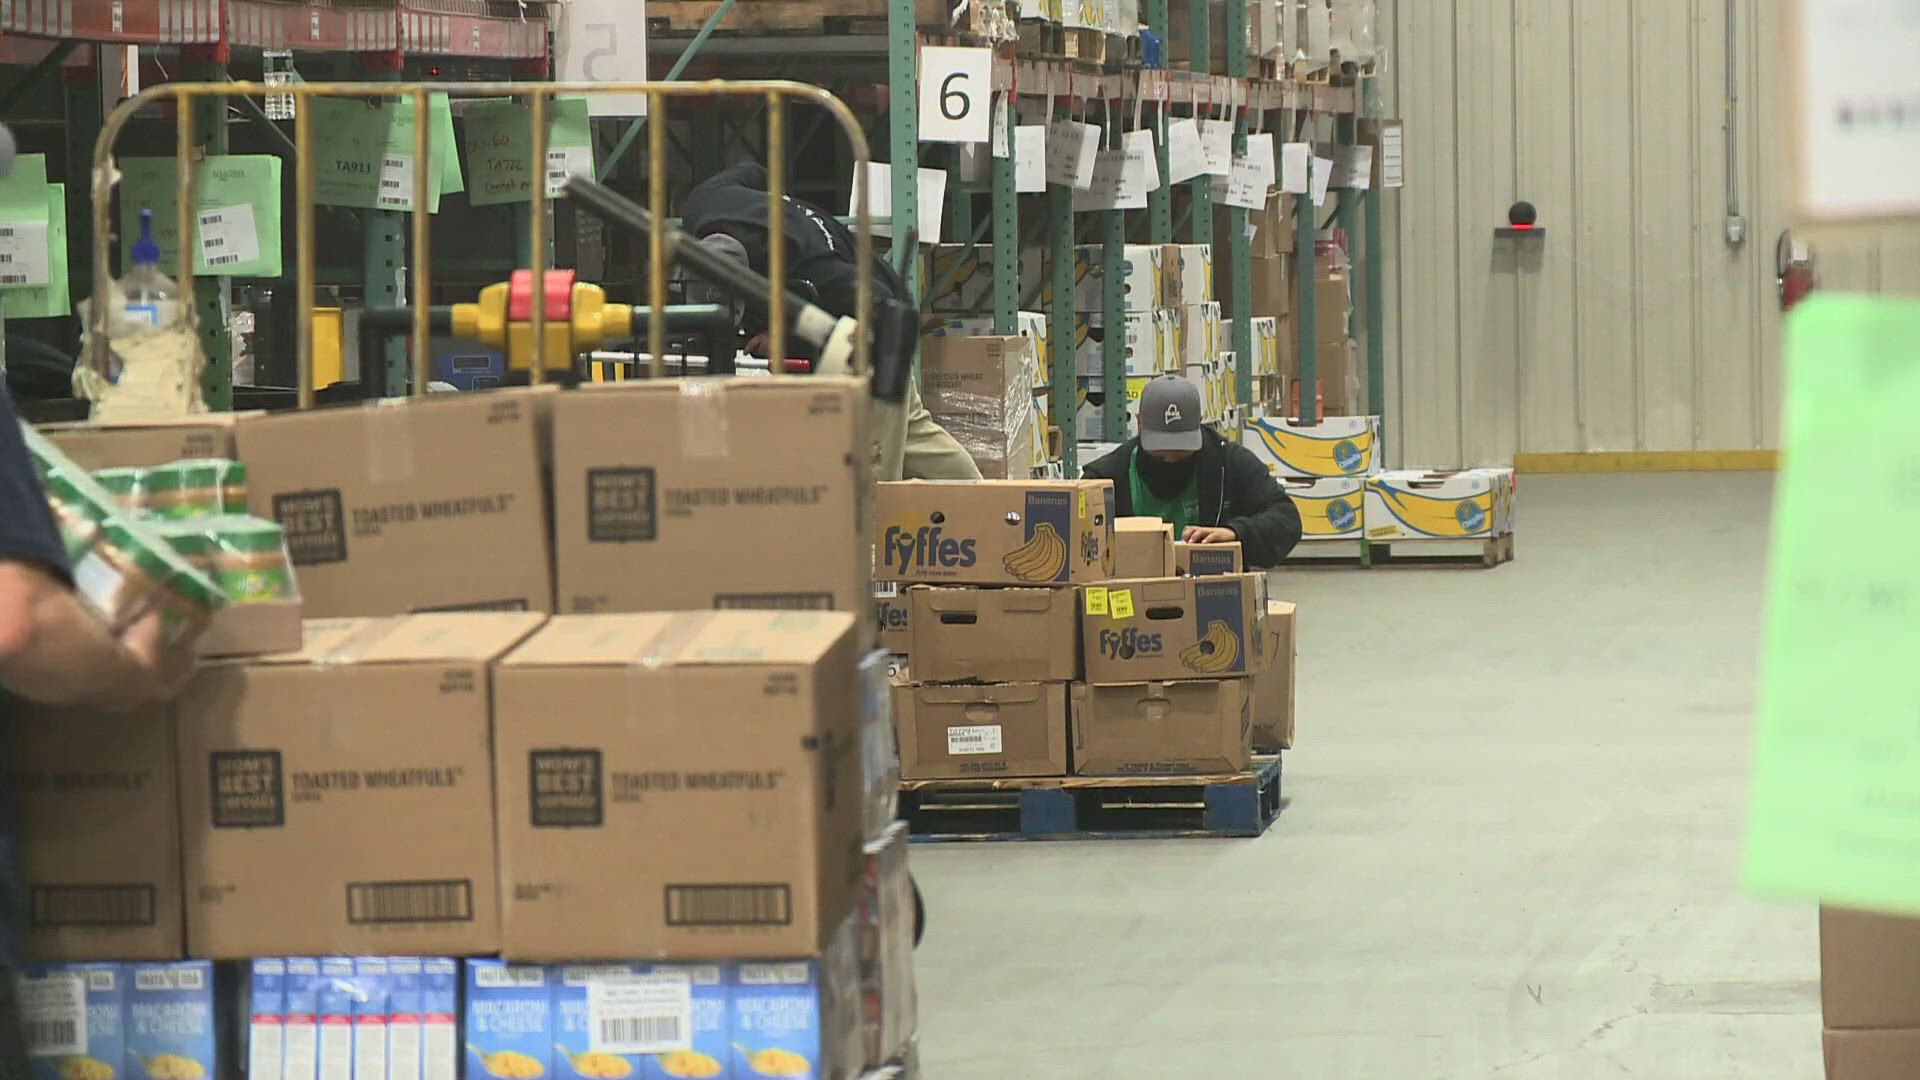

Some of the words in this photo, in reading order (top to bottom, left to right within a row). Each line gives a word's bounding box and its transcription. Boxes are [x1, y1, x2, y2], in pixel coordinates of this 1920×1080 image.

[939, 72, 971, 120] 6
[336, 160, 372, 174] TA911
[1028, 494, 1068, 506] Bananas
[1192, 553, 1232, 565] Bananas
[1197, 586, 1239, 598] Bananas
[292, 770, 360, 791] TOASTED
